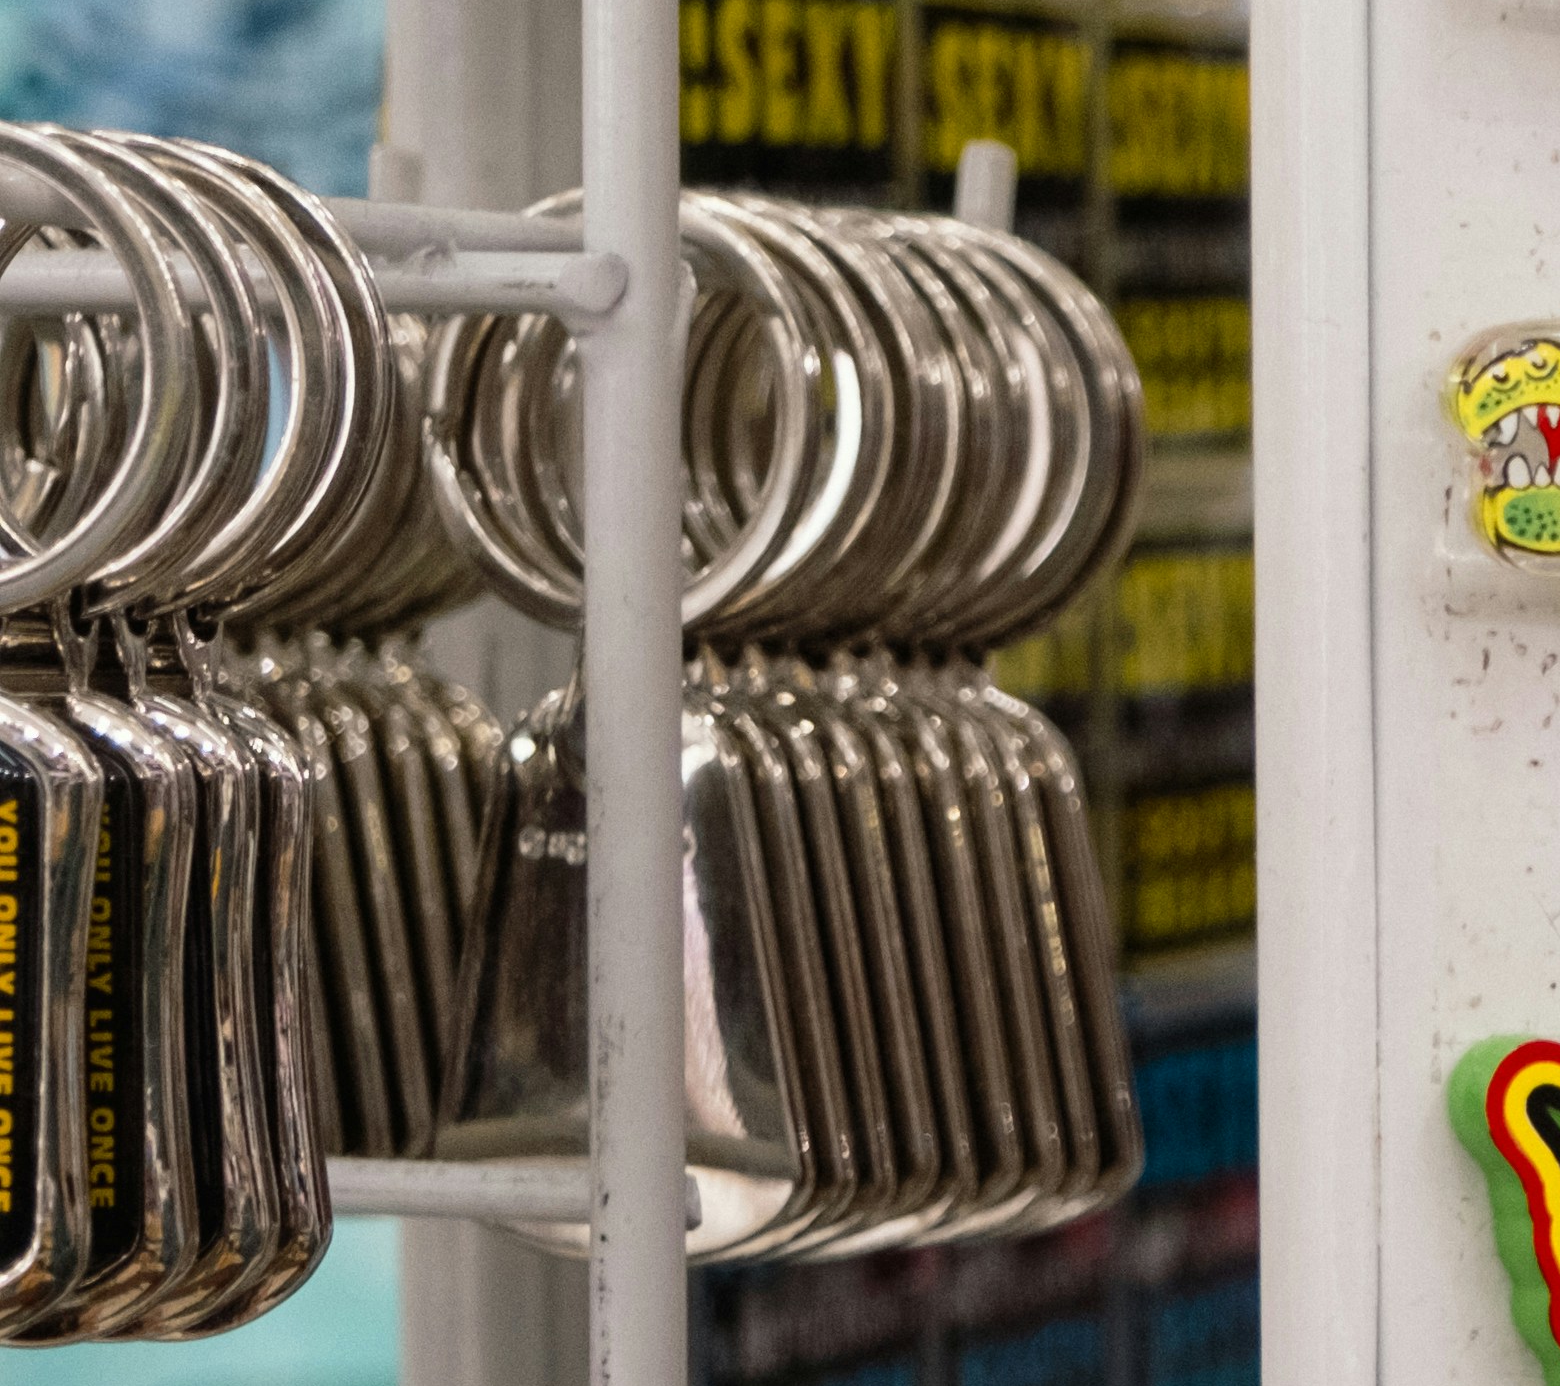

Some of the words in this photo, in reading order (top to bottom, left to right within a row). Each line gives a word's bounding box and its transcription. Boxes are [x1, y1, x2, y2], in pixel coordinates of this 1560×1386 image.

[87, 896, 112, 995] ONLY
[89, 1009, 114, 1092] LIVE
[90, 1107, 115, 1208] ONCE
